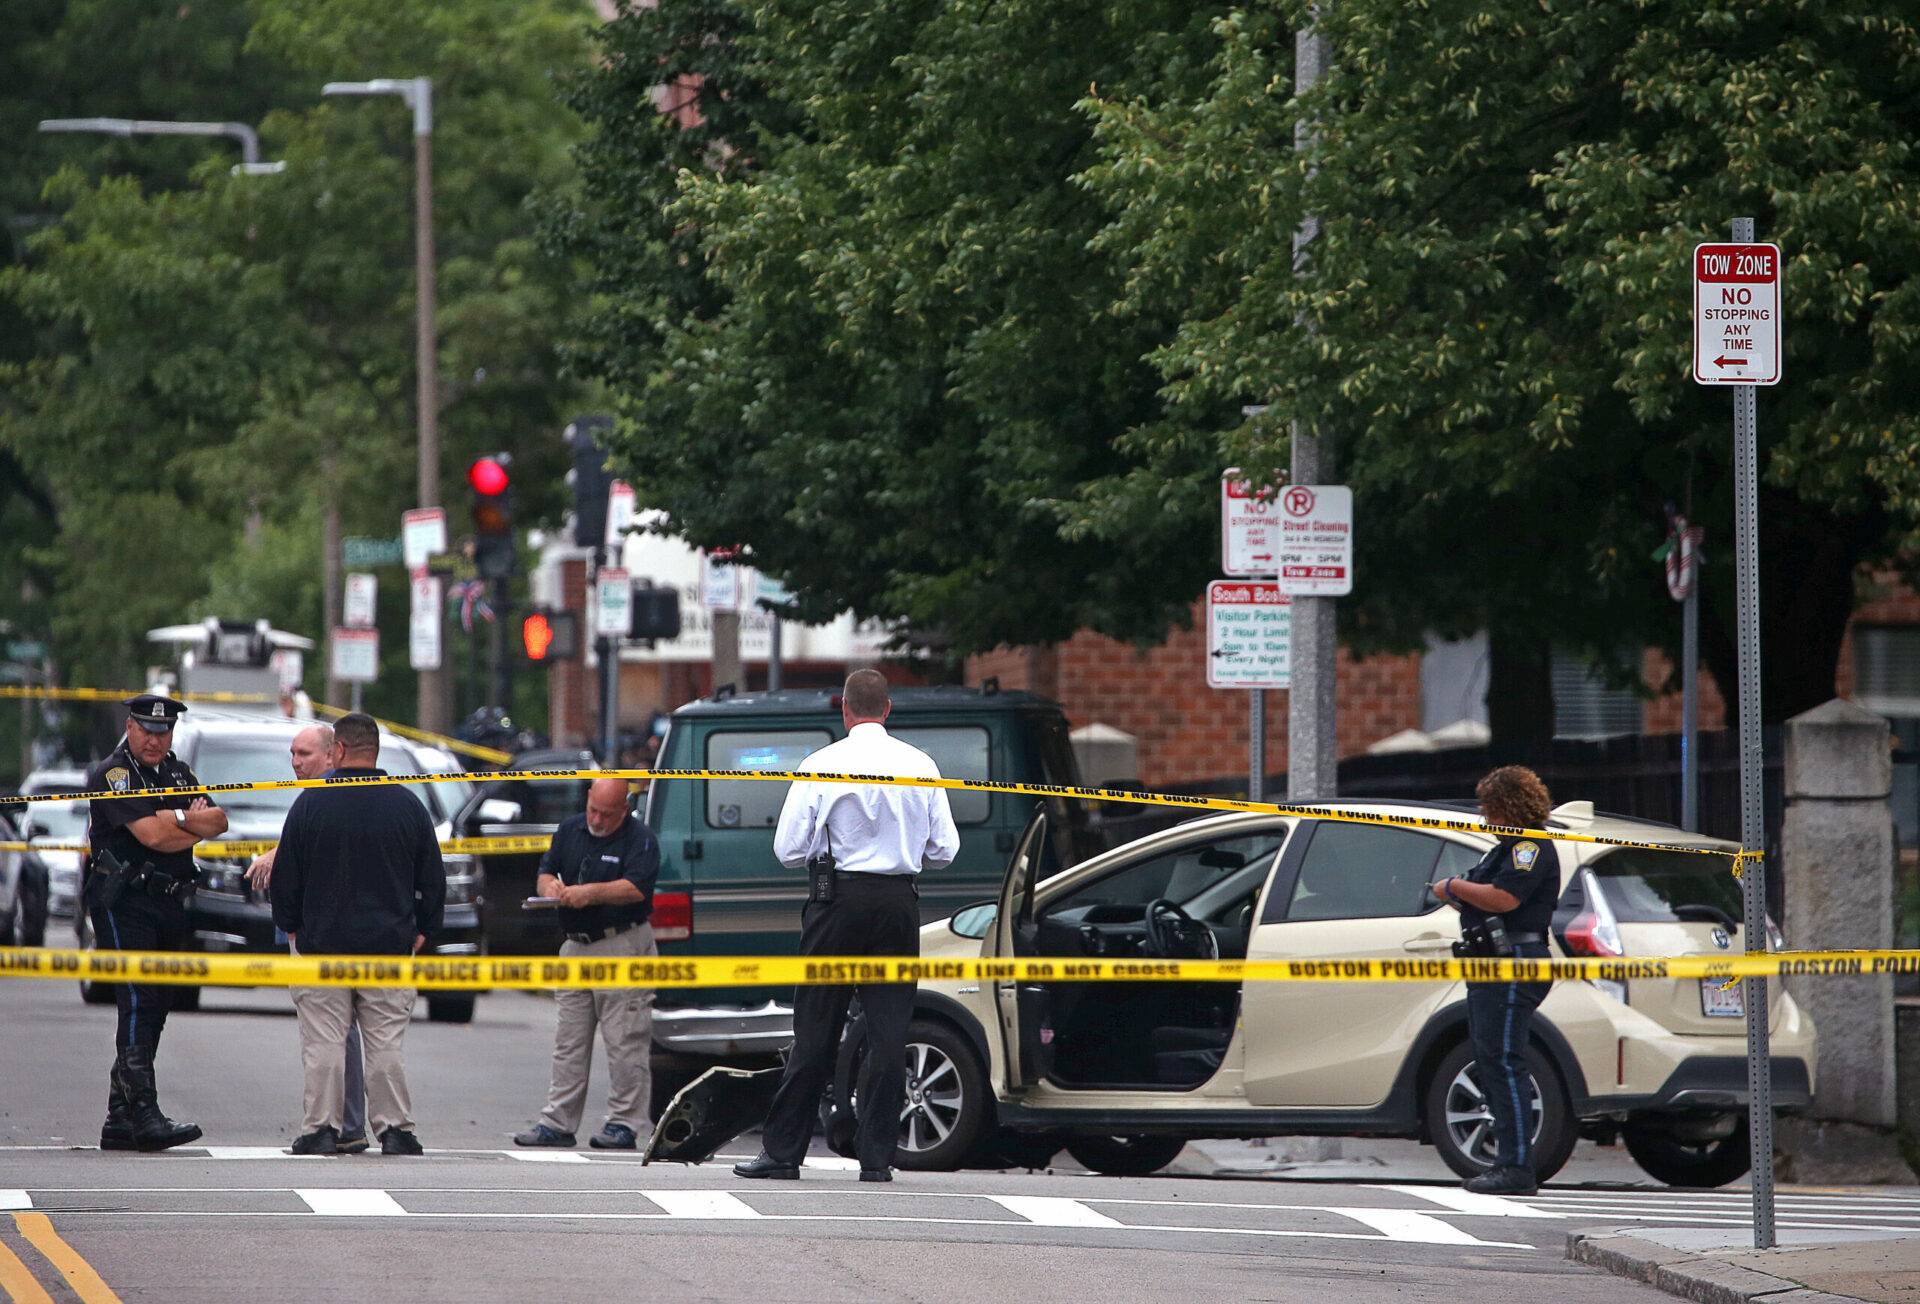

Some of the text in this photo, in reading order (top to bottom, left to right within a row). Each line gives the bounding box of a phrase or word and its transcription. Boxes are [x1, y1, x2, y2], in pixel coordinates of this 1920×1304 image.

[1702, 254, 1772, 276] TOW ZONE
[1722, 288, 1752, 305] NO
[1705, 308, 1770, 320] STOPPING
[1724, 324, 1751, 335] ANY
[1723, 339, 1753, 350] TIME
[1243, 503, 1267, 514] NO
[1283, 520, 1348, 534] Street Cleaning
[1285, 567, 1337, 577] Tow Zone
[1212, 585, 1250, 602] South
[1216, 609, 1249, 621] Visitor
[1221, 627, 1229, 638] 2
[1233, 627, 1257, 637] Hour
[52, 954, 80, 972] DO
[89, 956, 128, 974] NOT
[139, 957, 210, 977] CROSS
[320, 961, 697, 981] BOSTON POLICE LINE DO NOT CROSS
[805, 963, 1181, 980] BOSTON POLICE LINE DO NOT CROSS
[1289, 960, 1668, 980] BOSTON POLICE LINE DO NOT CROSS
[1778, 957, 1862, 976] BOSTON
